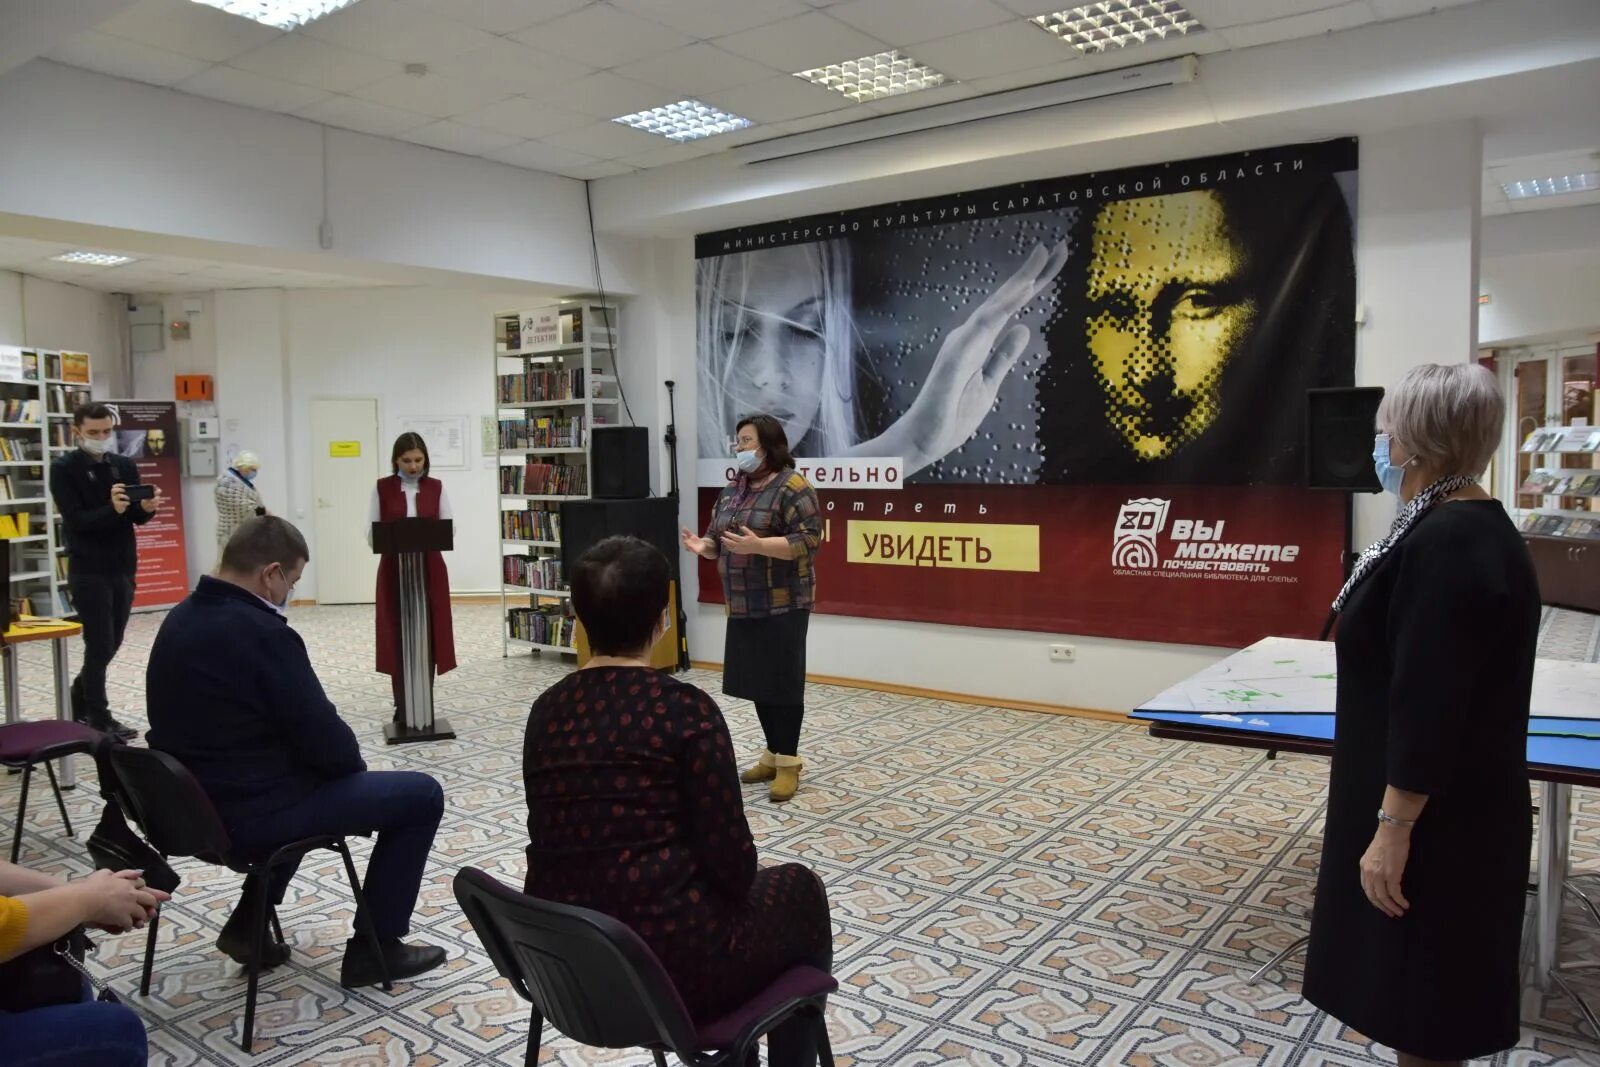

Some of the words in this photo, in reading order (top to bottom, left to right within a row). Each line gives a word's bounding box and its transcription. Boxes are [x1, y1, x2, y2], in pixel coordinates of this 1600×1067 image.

[723, 222, 860, 249] МИНИСТЕРСТВО
[873, 205, 976, 228] КУЛЬТУРЫ
[992, 177, 1161, 211] САРАТОВСКОЙ
[1181, 159, 1303, 186] ОБЛАСТИ
[863, 533, 992, 567] УВИДЕТЬ
[1113, 569, 1152, 577] ОБЛАСТНАЯ
[1152, 571, 1203, 579] СПЕЦИАЛЬНАЯ
[1250, 575, 1266, 583] ДЛЯ
[1267, 575, 1298, 583] СЛЕПЫХ
